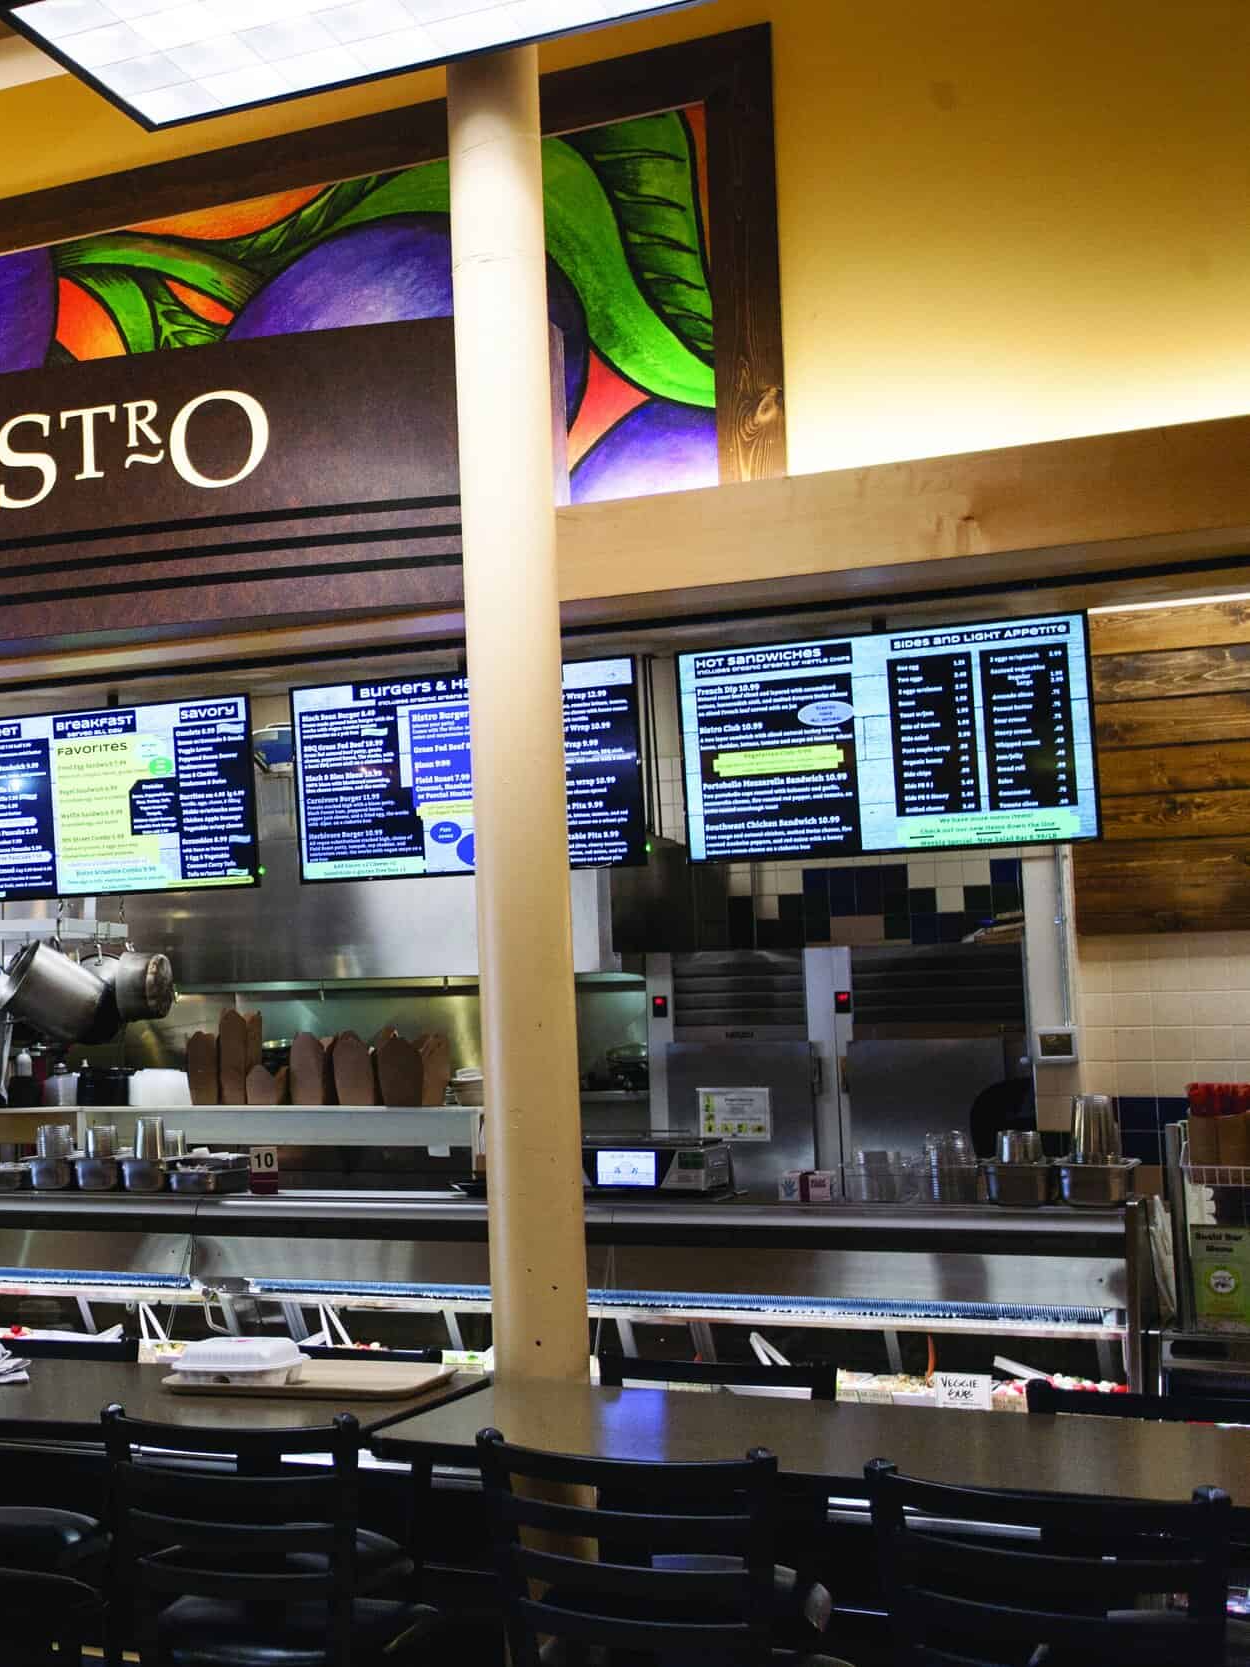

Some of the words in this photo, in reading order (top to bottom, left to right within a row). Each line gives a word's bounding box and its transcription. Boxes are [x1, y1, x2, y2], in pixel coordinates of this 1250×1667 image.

[435, 680, 446, 691] &
[785, 774, 824, 784] Sandwich
[778, 817, 816, 827] Sandwich
[254, 1152, 274, 1169] 10
